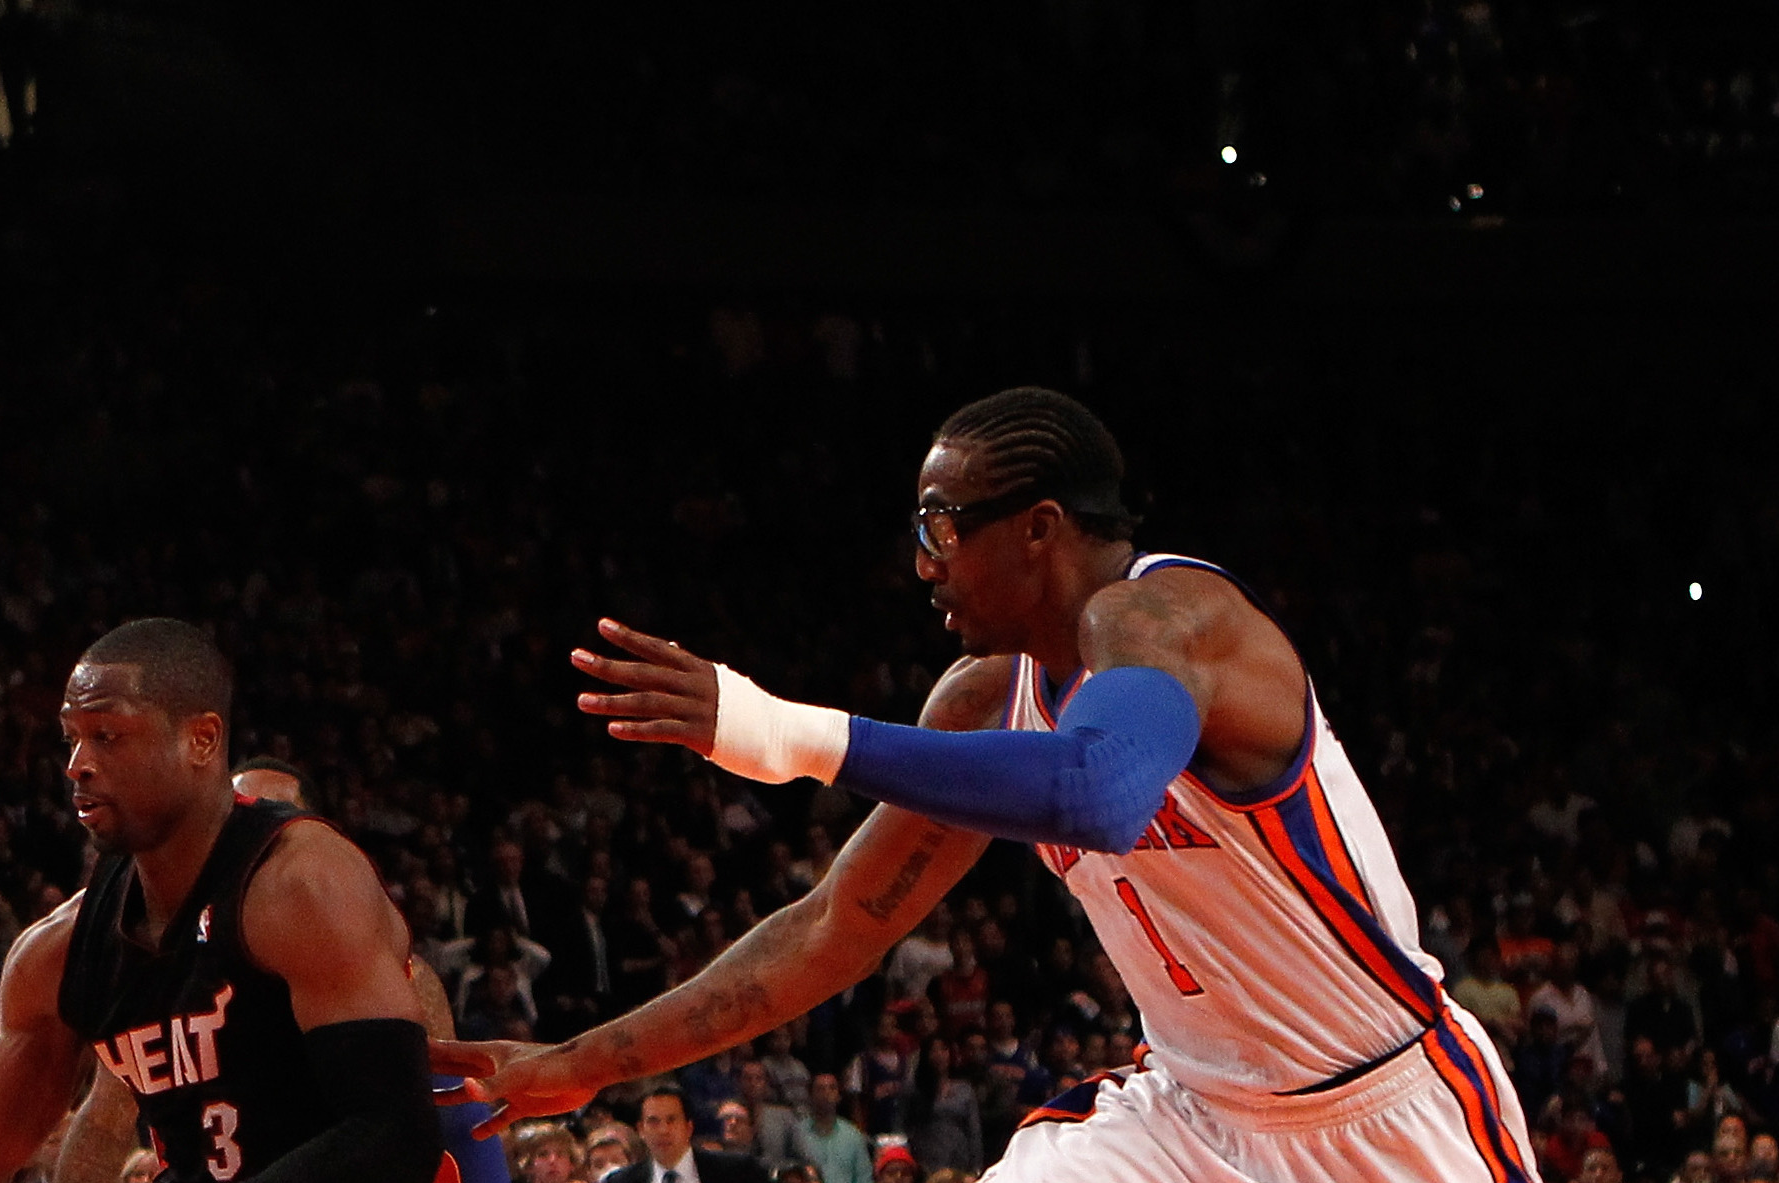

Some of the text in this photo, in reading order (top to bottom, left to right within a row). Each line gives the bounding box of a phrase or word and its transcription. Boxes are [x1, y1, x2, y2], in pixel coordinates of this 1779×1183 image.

[1113, 876, 1205, 997] 1
[93, 984, 234, 1094] HEAT
[202, 1102, 242, 1181] 3
